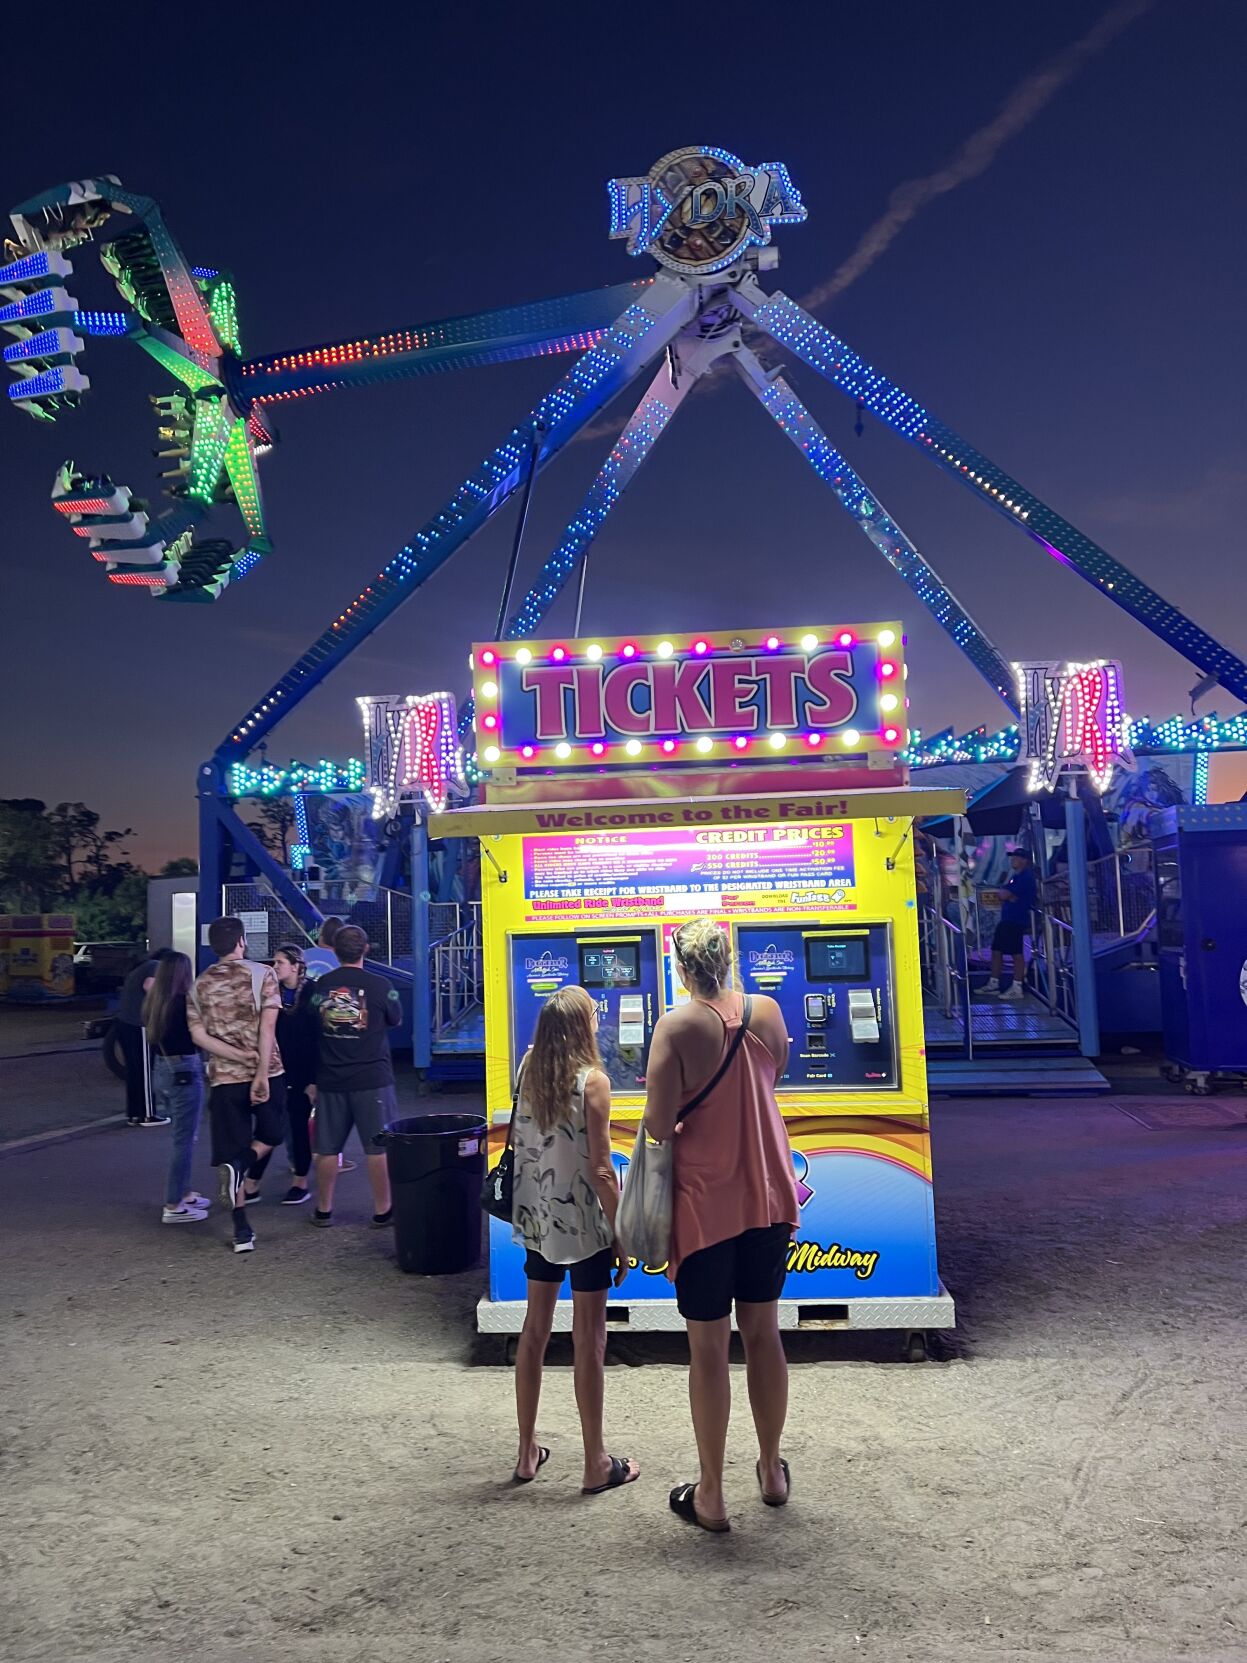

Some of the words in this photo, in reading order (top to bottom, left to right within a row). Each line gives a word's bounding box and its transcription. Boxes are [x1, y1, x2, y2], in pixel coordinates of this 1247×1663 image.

[608, 160, 808, 256] HYDRA
[522, 651, 856, 740] TICKETS
[1010, 660, 1137, 793] HYDRA
[355, 692, 470, 820] HYDRA
[535, 811, 674, 828] Welcome
[682, 808, 713, 822] to
[720, 804, 770, 820] the
[778, 800, 848, 818] Fair!
[574, 836, 628, 845] NOTICE
[696, 830, 768, 844] CREDIT
[772, 826, 844, 841] PRICES
[529, 889, 560, 899] PLEASE
[561, 888, 582, 897] TAKE
[584, 887, 617, 897] RECEIPT
[619, 886, 636, 895] FOR
[638, 884, 688, 894] WRISTBAND
[689, 884, 701, 892] TO
[703, 883, 719, 891] THE
[721, 882, 773, 891] DESIGNATED
[774, 880, 827, 889] WRISTBAND
[828, 878, 852, 887] AREA
[532, 899, 582, 910] Unlimited
[583, 898, 608, 908] Ride
[610, 896, 664, 907] Wristband
[786, 1241, 879, 1278] Midway
